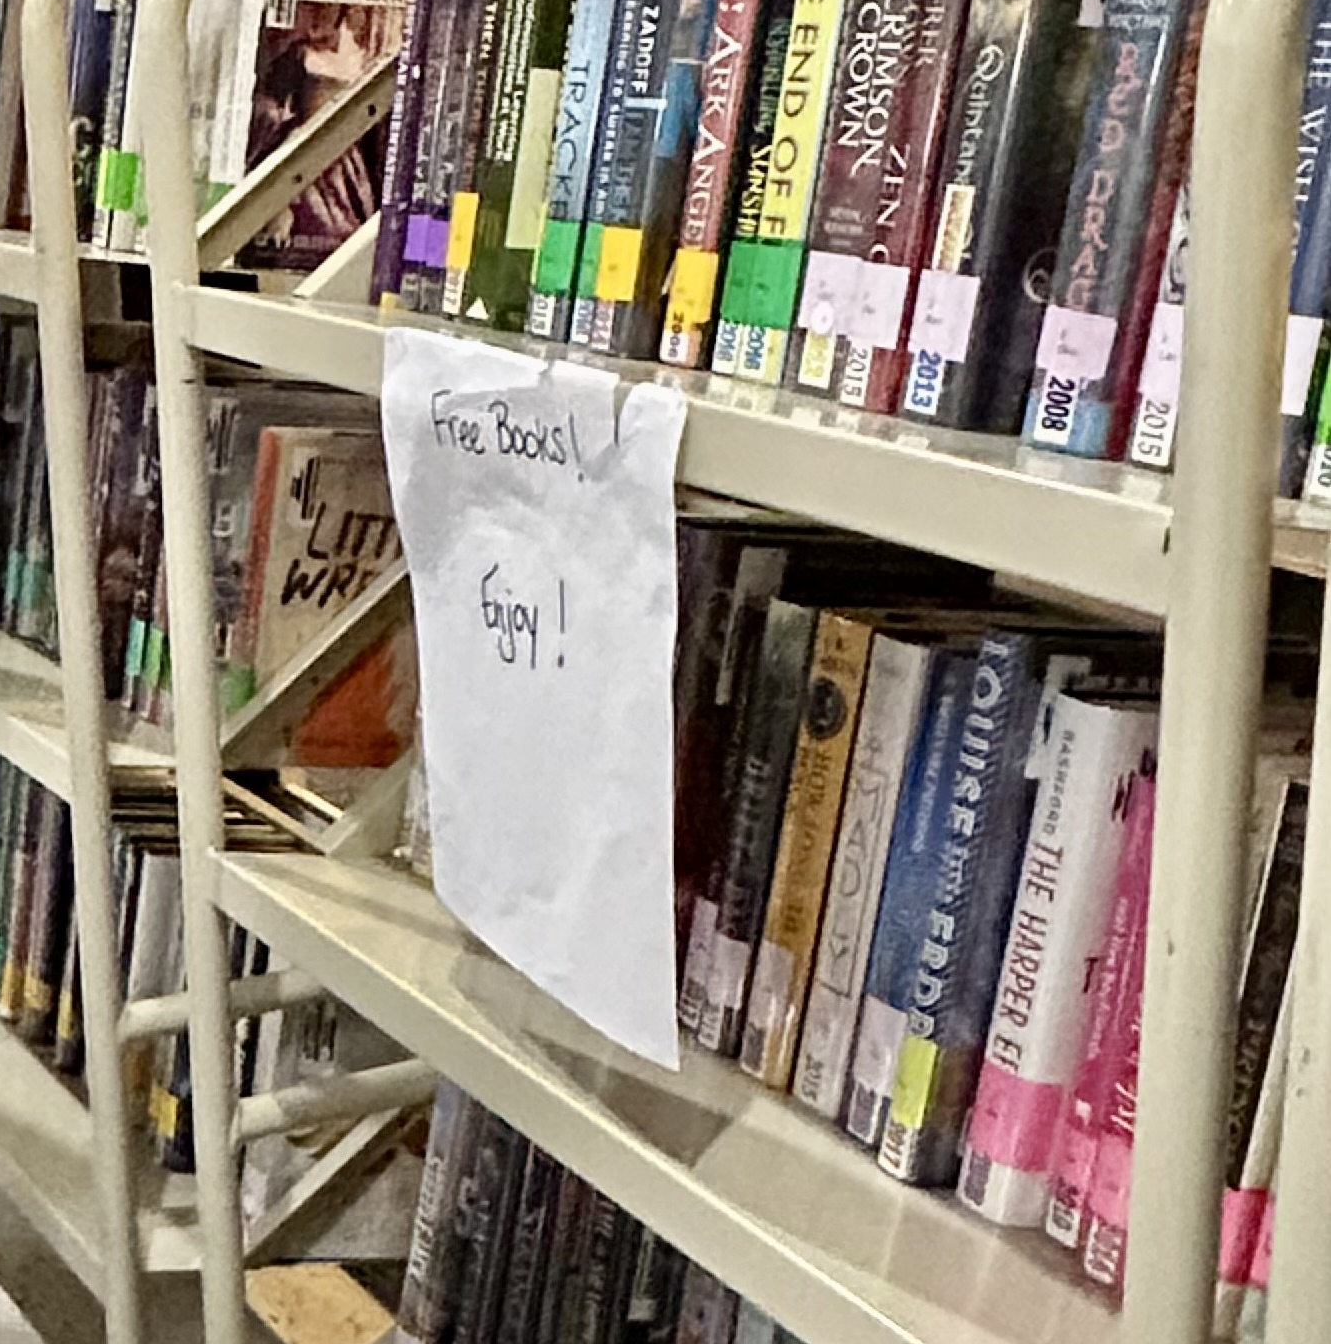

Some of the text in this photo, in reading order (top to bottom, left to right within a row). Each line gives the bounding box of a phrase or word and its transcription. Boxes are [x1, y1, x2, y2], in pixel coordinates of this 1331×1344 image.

[631, 4, 658, 94] ZADOFF
[782, 23, 821, 118] END
[837, 1, 881, 148] CROWN
[681, 26, 743, 249] ARKANGE
[768, 135, 799, 203] OF
[843, 348, 868, 397] 2015
[910, 350, 943, 408] 2013
[1041, 376, 1076, 433] 2008
[430, 389, 586, 482] Free Books!
[1136, 400, 1172, 458] 2015
[1021, 840, 1066, 903] THE
[993, 908, 1051, 1030] HARPER
